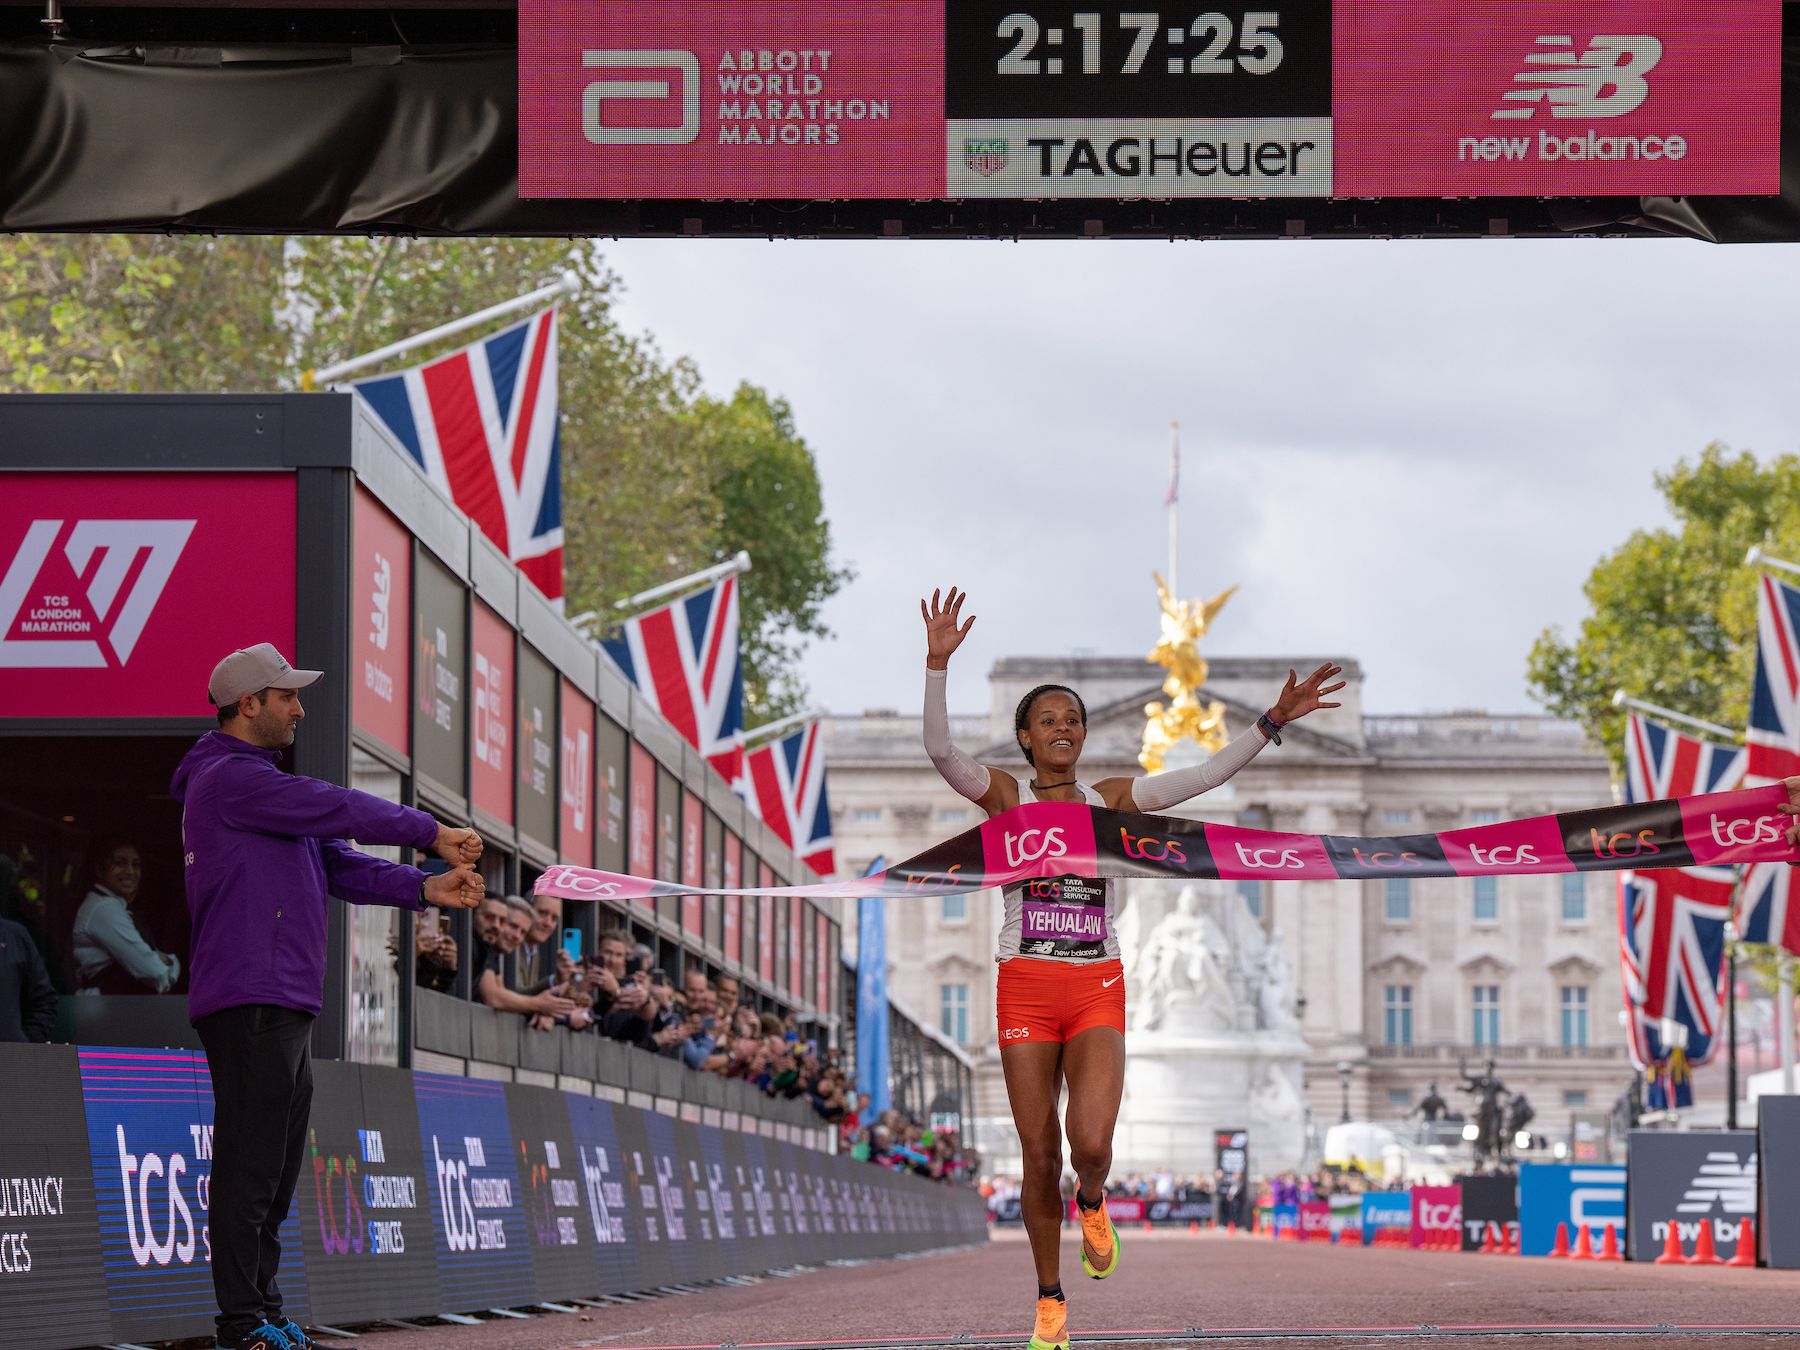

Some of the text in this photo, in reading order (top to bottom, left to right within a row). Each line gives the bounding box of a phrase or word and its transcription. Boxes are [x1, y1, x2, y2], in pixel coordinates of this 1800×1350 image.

[997, 12, 1284, 76] 2:17:25
[718, 49, 832, 71] ABBOTT
[718, 74, 824, 95] WORLD
[718, 99, 890, 120] MARATHON
[718, 123, 840, 145] MAJORS
[1458, 129, 1689, 160] new balance
[30, 608, 81, 620] LONDON
[43, 595, 69, 607] TCS
[20, 621, 91, 633] MARATHON
[1590, 827, 1660, 859] tcs
[1710, 813, 1779, 847] tcs
[1004, 826, 1067, 868] tcs
[1119, 826, 1187, 864] tcs
[1234, 842, 1304, 869] tcs
[1352, 847, 1423, 868] tcs
[1469, 842, 1541, 867] tcs
[554, 867, 622, 898] tcs
[1029, 879, 1060, 898] tcs
[1063, 886, 1103, 896] CONSULTANCY
[1063, 893, 1090, 901] SERVICES
[1027, 910, 1102, 935] YEHUALAW
[1053, 948, 1098, 957] new balance
[358, 1129, 385, 1163] TATA
[116, 1124, 195, 1267] tcs
[309, 1128, 364, 1256] tcs
[363, 1174, 416, 1209] CONSULTANCY
[433, 1134, 476, 1252] tcs
[368, 1220, 405, 1254] SERVICES
[1651, 1220, 1701, 1242] nw
[0, 1232, 31, 1273] CES
